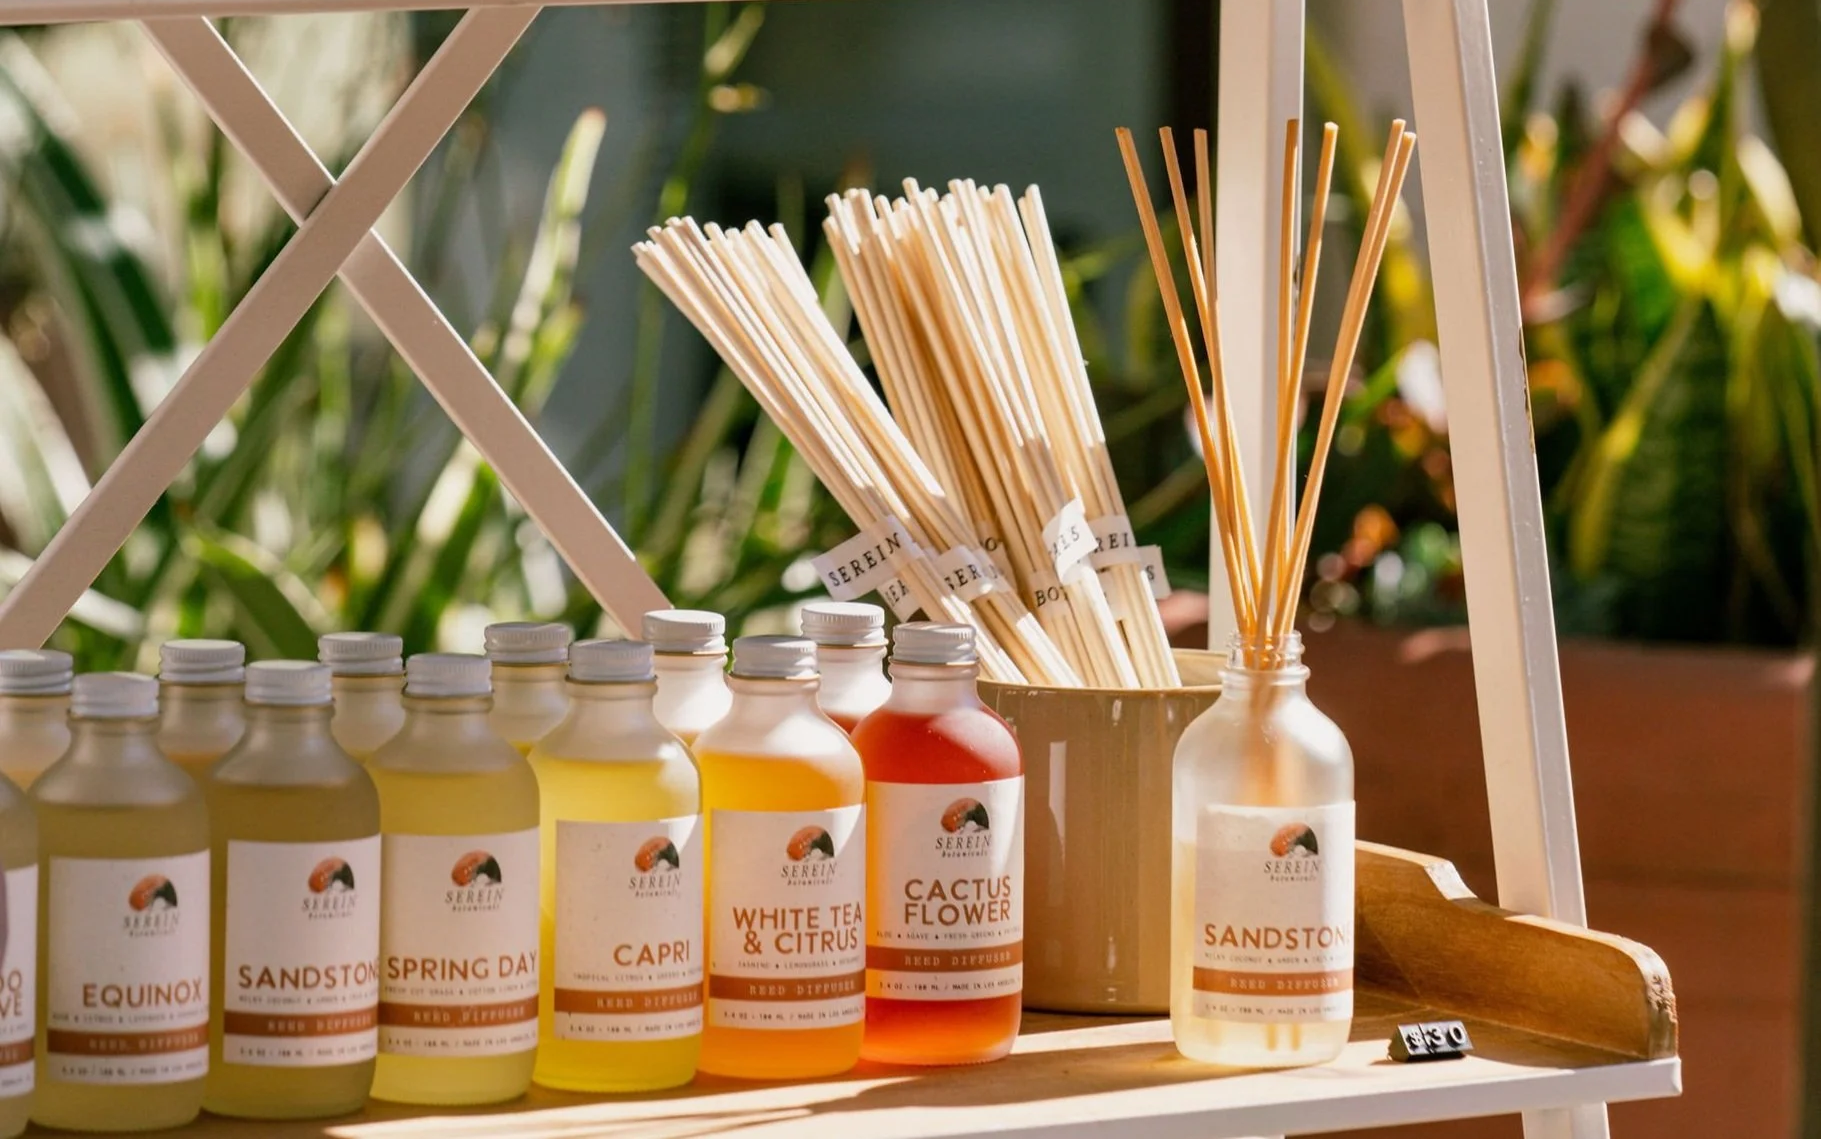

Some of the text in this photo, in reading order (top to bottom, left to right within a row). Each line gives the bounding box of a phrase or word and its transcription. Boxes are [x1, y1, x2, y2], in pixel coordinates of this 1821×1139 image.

[828, 531, 901, 588] SEREIN
[935, 833, 992, 850] SEREIN
[780, 862, 837, 878] SEREIN
[1263, 859, 1321, 874] SEREIN
[628, 872, 682, 890] SEREIN
[904, 875, 1011, 901] CACTUS
[445, 886, 504, 905] SEREIN
[733, 901, 862, 930] WHITE TEA
[904, 899, 1011, 926] FLOWER
[743, 927, 858, 955] & CITRUS
[1204, 923, 1350, 950] SANDSTON
[387, 949, 537, 981] SPRING DAY
[613, 939, 690, 966] CAPRI
[904, 955, 940, 966] REED
[238, 958, 379, 990] SANDSTON
[83, 977, 202, 1009] EQUINOX
[749, 984, 786, 996] REED
